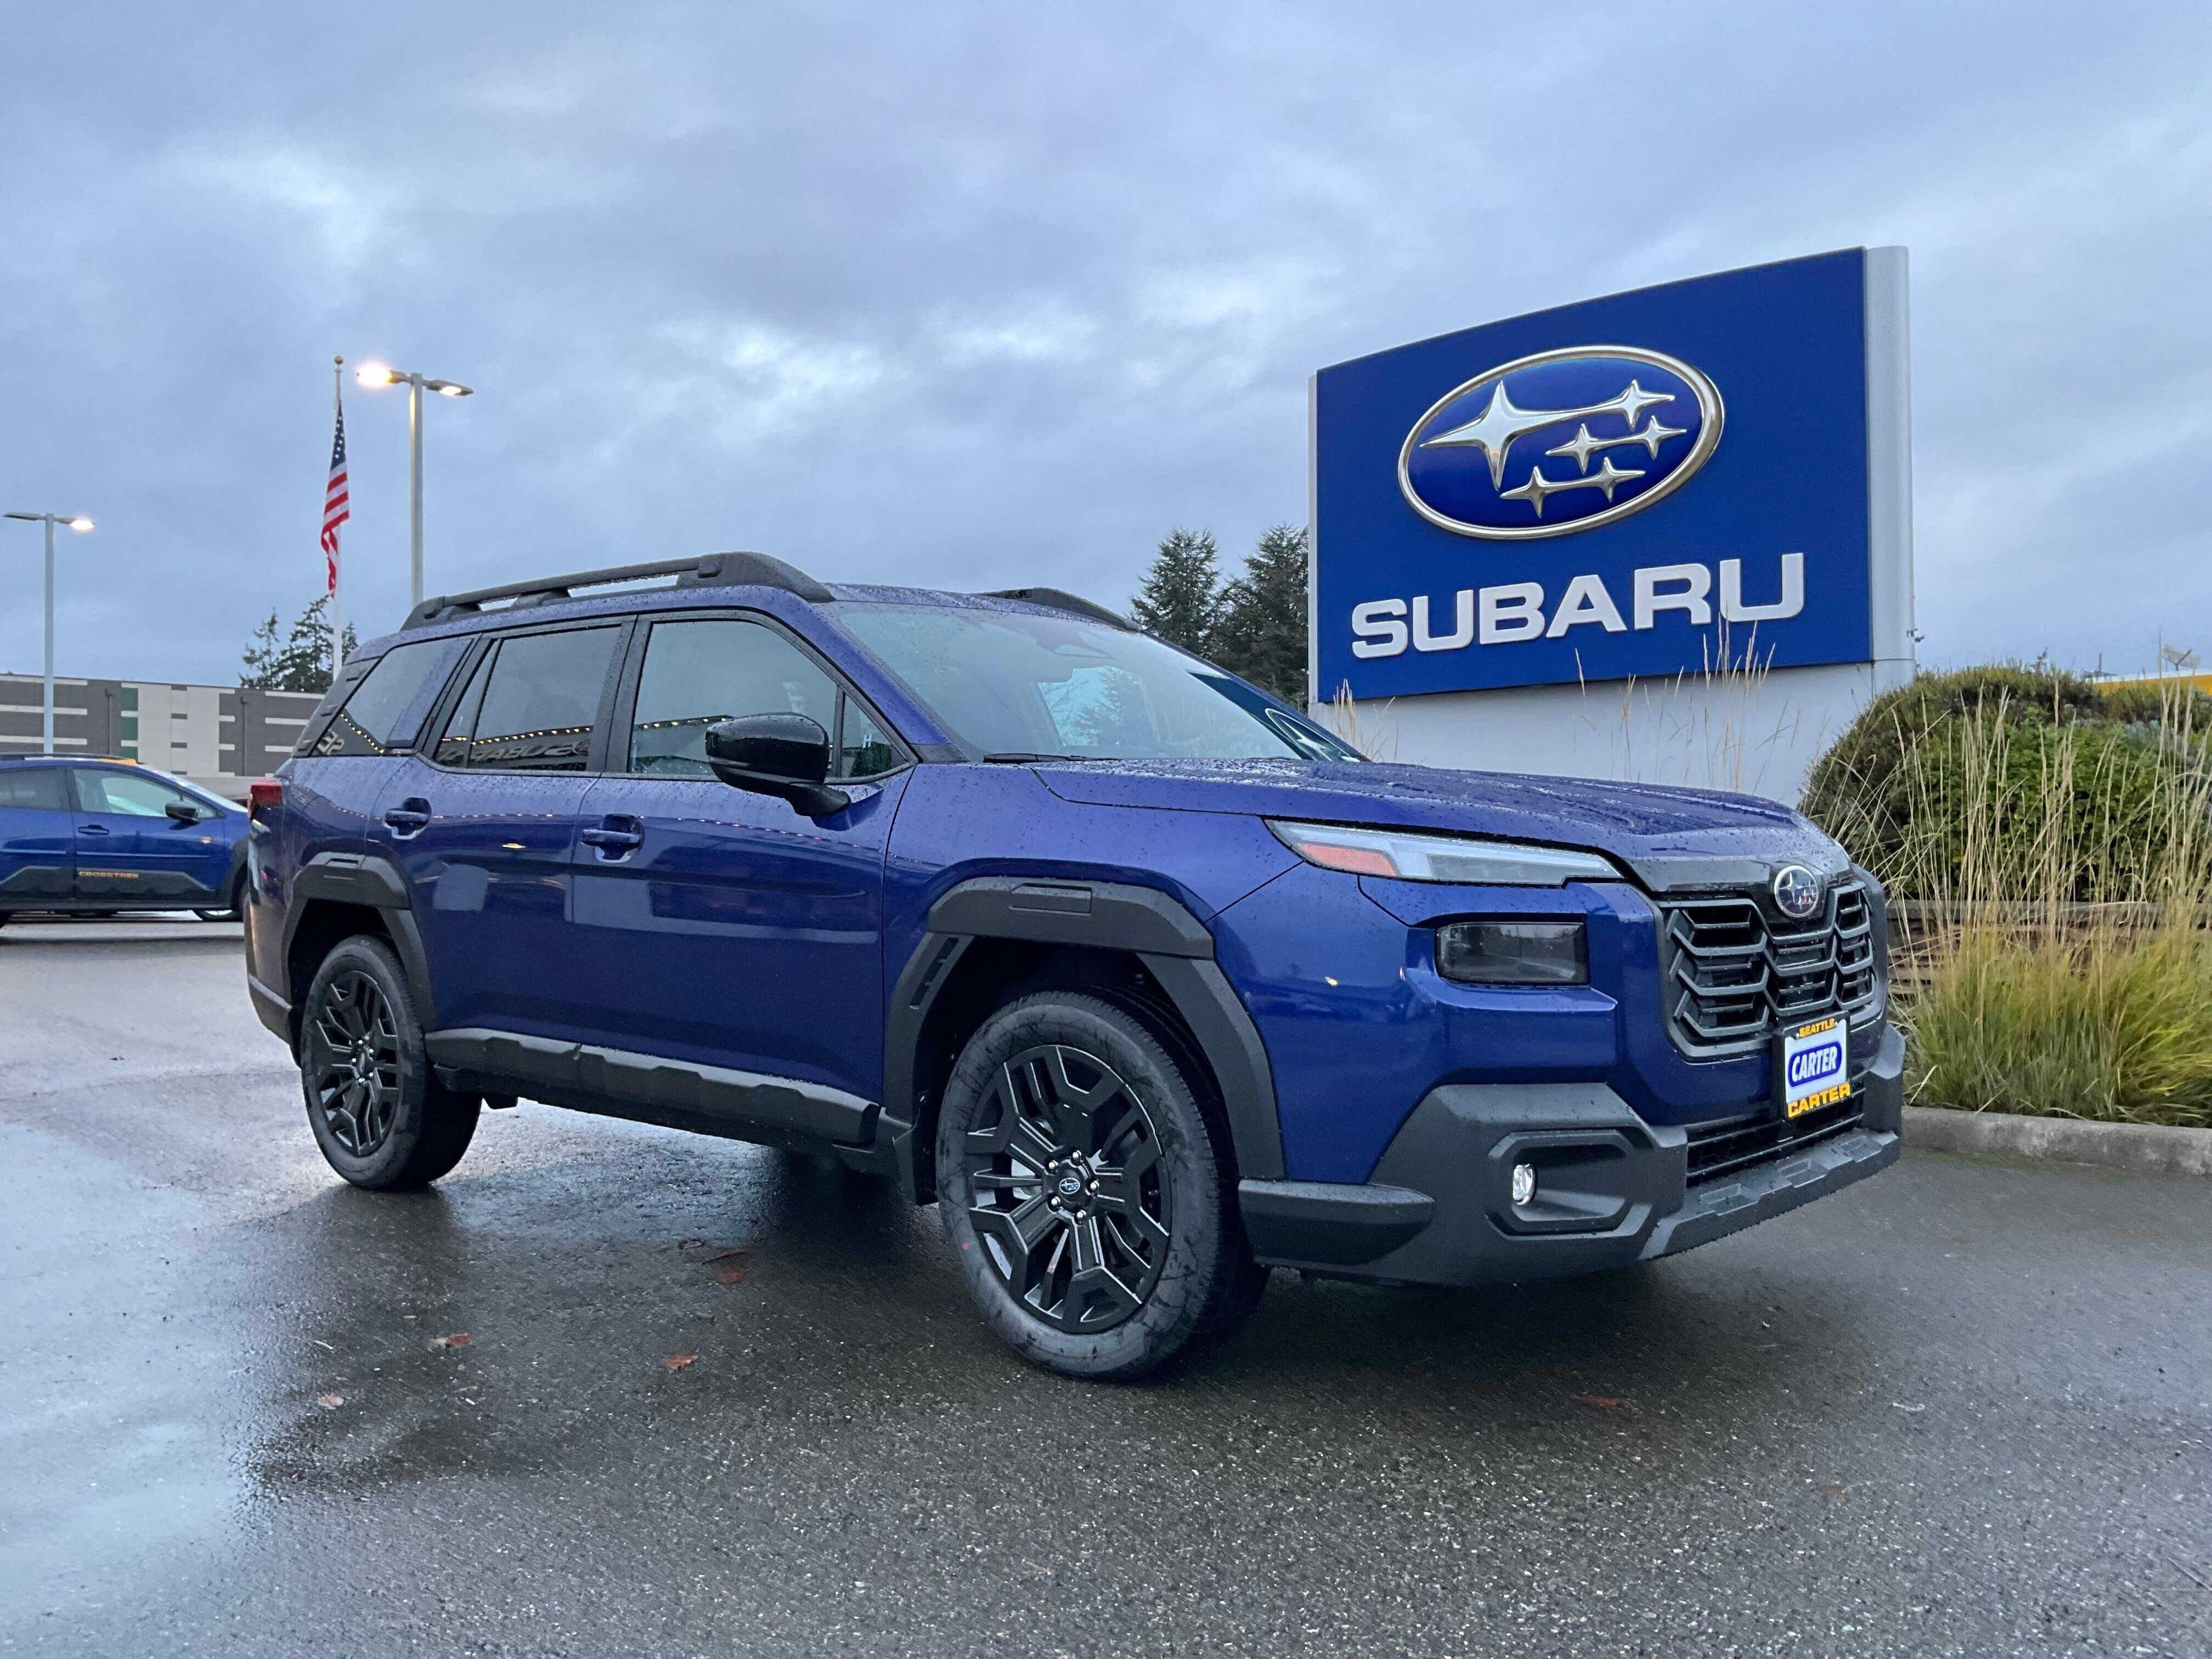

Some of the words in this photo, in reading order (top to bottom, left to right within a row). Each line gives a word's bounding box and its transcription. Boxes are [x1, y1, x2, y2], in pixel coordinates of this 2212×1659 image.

[1351, 552, 1804, 658] SUBARU
[1799, 1018, 1835, 1037] SEATTLE
[1791, 1046, 1838, 1082] CARTER
[1788, 1083, 1850, 1118] CARTER
